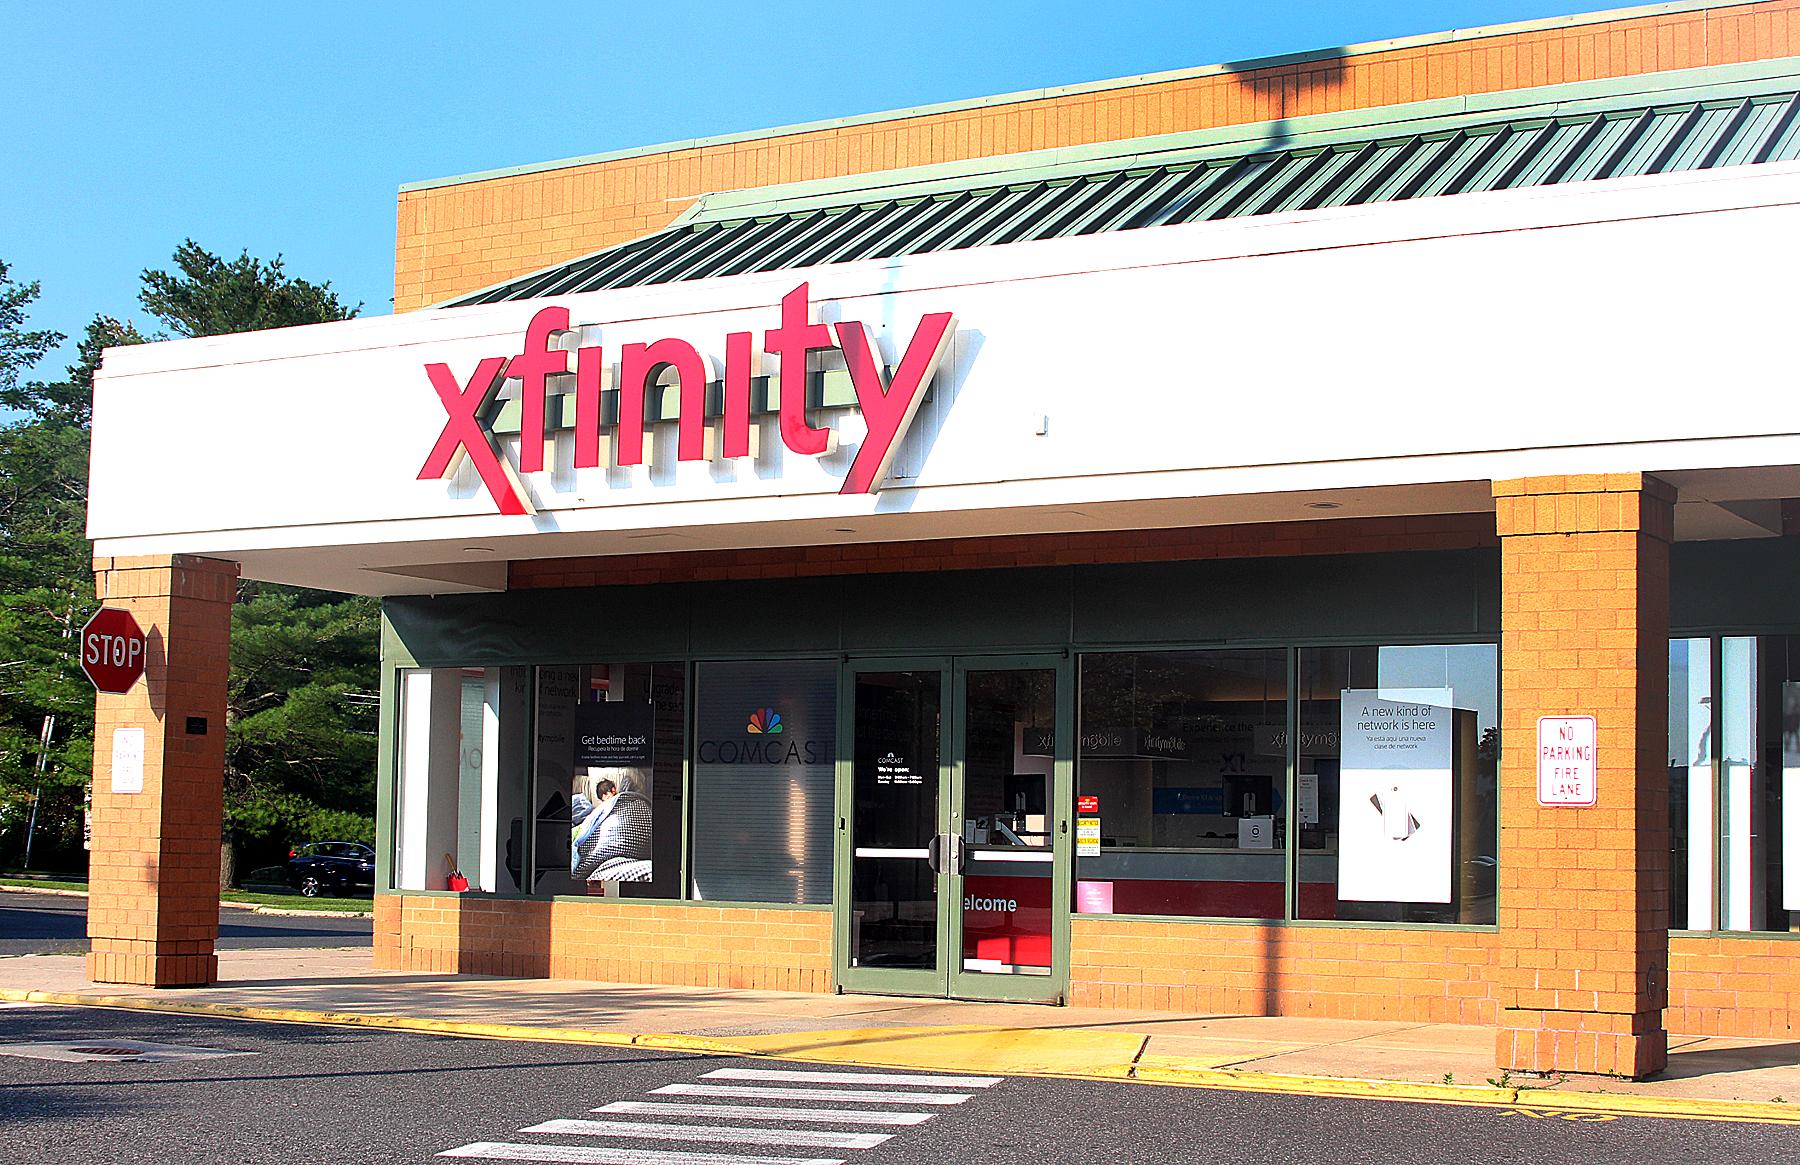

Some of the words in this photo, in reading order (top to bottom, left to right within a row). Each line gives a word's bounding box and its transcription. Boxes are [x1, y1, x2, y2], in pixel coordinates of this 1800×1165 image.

[416, 281, 958, 516] xfinity
[87, 633, 142, 668] STOP
[1361, 706, 1370, 717] A
[1372, 707, 1394, 717] new
[1396, 705, 1419, 717] kind
[1421, 704, 1433, 717] of
[1357, 720, 1399, 730] network
[1401, 719, 1410, 730] is
[1412, 719, 1436, 730] here
[581, 735, 595, 745] Get
[596, 734, 627, 745] bedtime
[628, 734, 647, 745] back
[1559, 726, 1574, 741] NO
[698, 740, 833, 764] COMCAST
[1543, 746, 1591, 761] PARKING
[1554, 767, 1579, 780] FIRE
[1552, 783, 1582, 796] LANE
[964, 894, 1017, 912] elcome
[1497, 1108, 1619, 1122] NO
